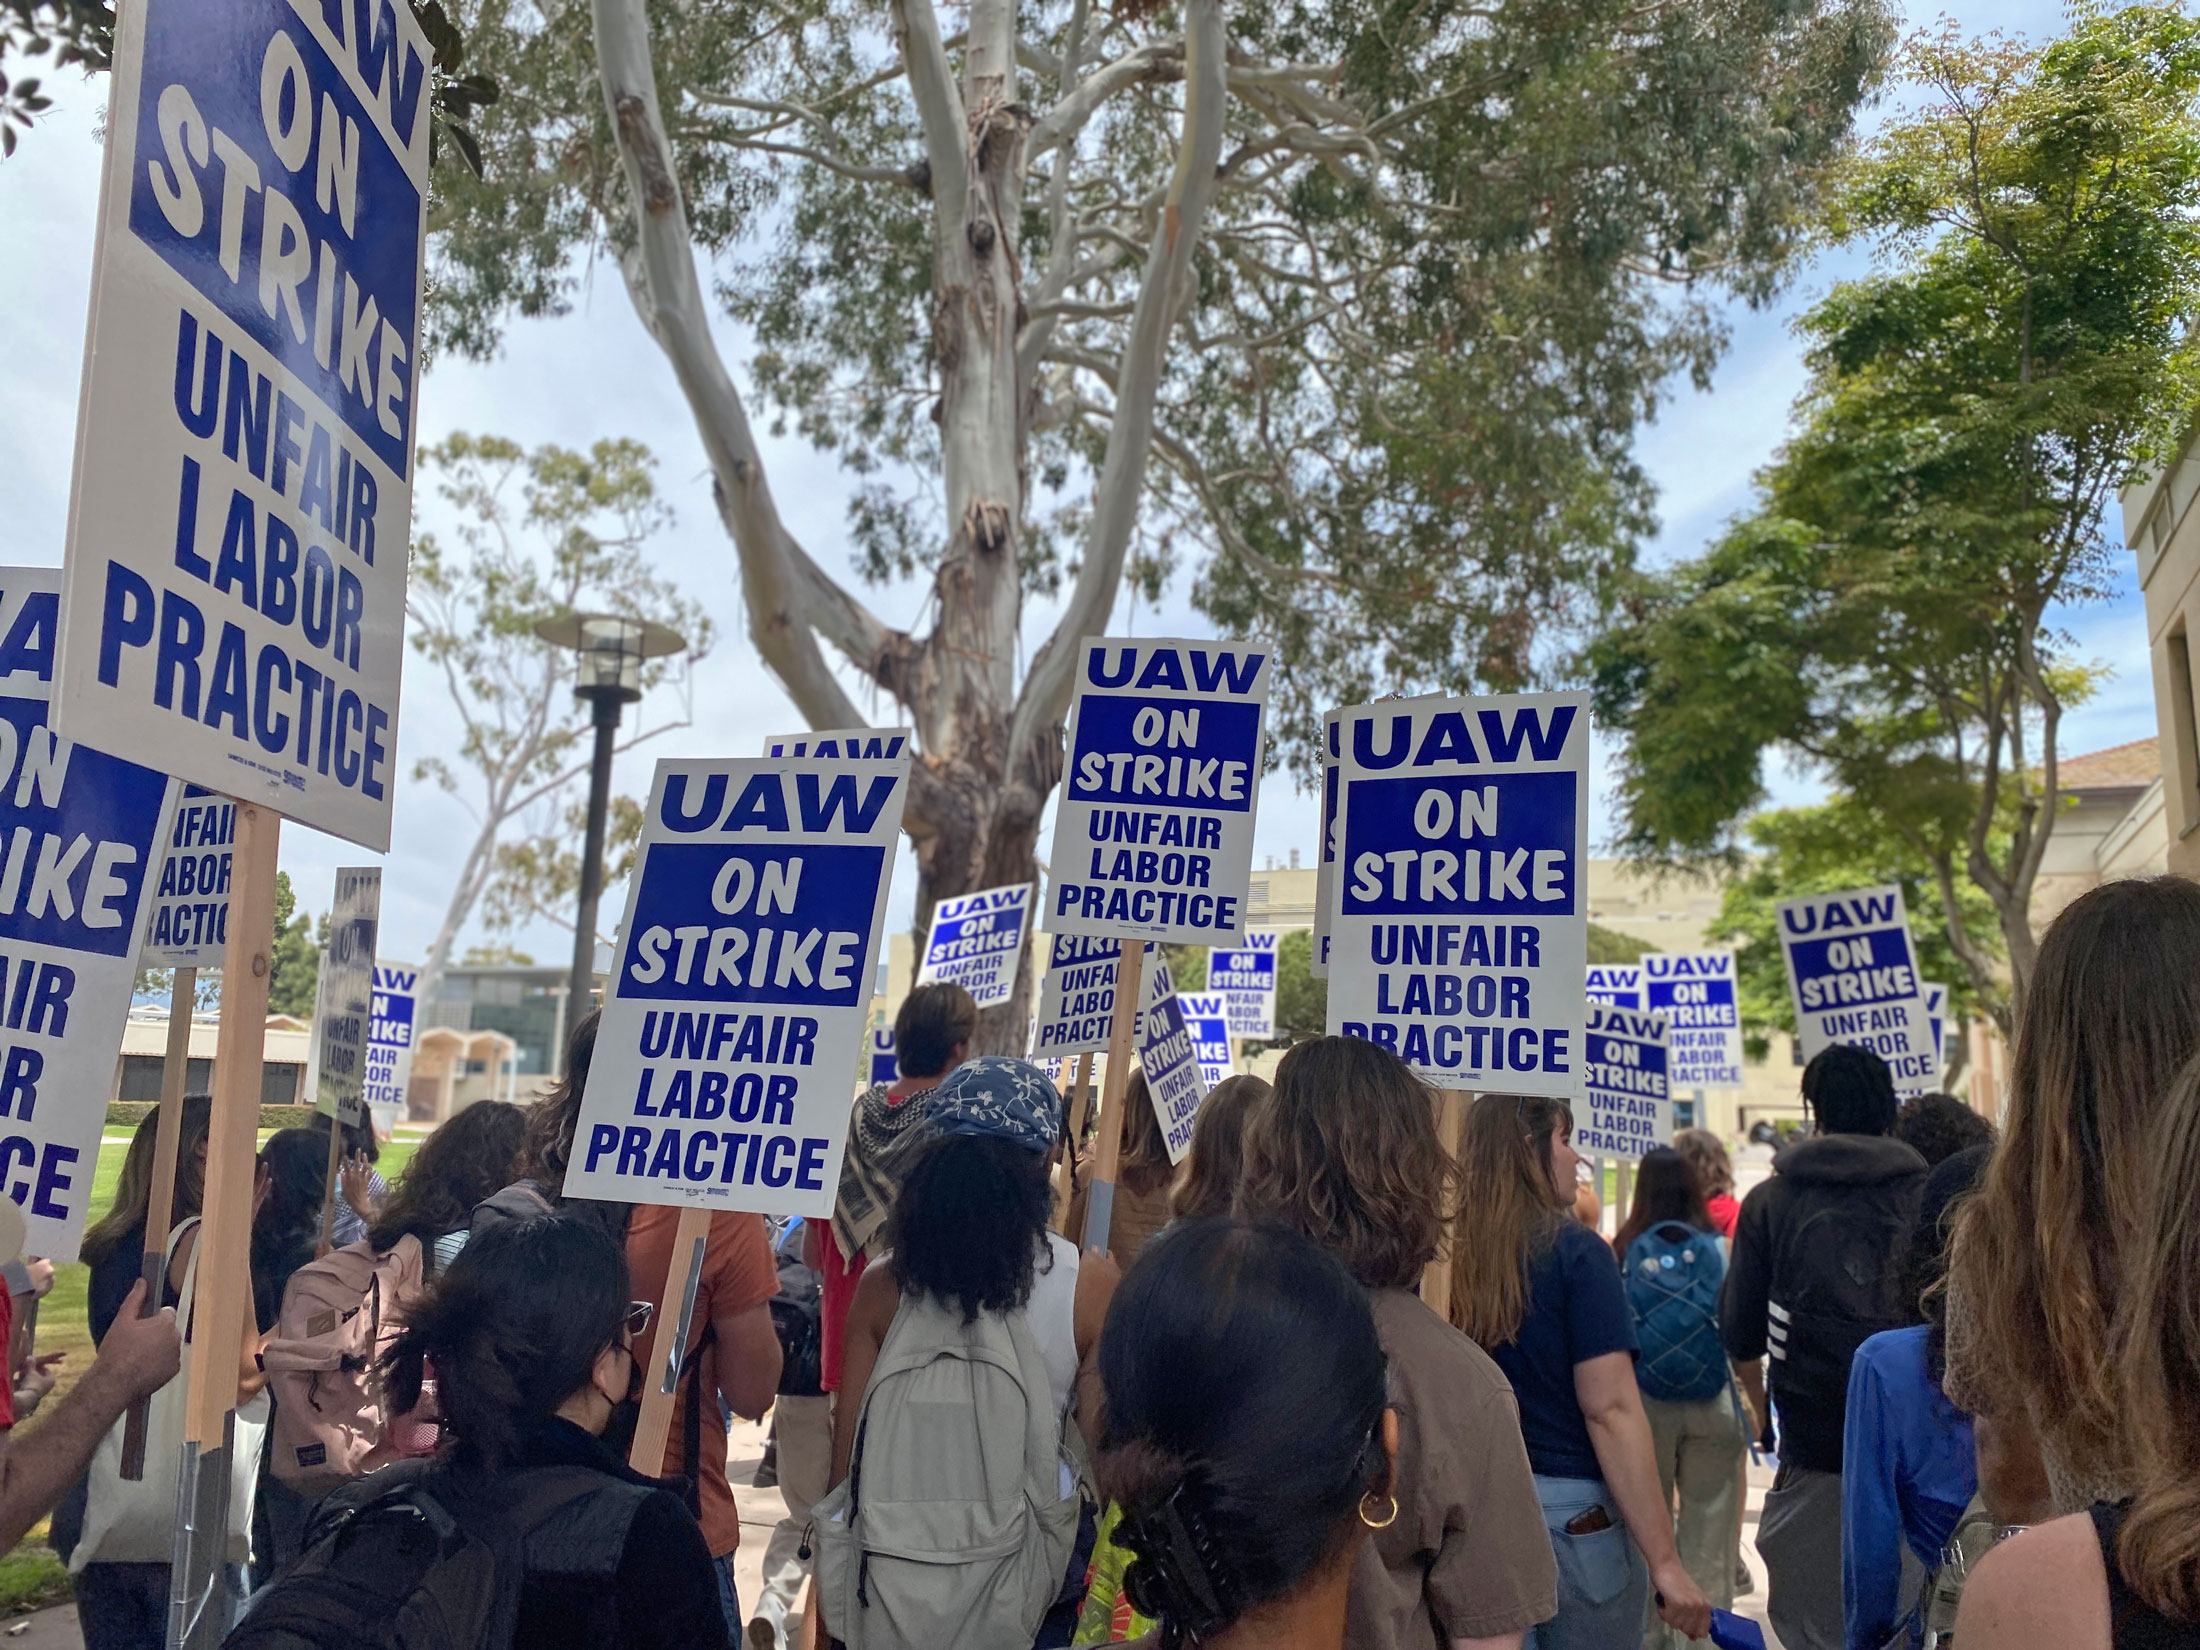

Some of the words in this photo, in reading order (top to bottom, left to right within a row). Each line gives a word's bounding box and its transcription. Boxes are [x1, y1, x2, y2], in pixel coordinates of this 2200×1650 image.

[261, 30, 359, 240] ON
[149, 84, 406, 441] STRIKE
[174, 308, 377, 567] UNFAIR
[175, 455, 364, 672] LABOR
[98, 559, 388, 801] PRACTICE
[1088, 647, 1265, 694] UAW
[1132, 706, 1200, 748] ON
[1353, 706, 1578, 770] UAW
[1076, 751, 1248, 800] STRIKE
[660, 774, 899, 833] UAW
[1414, 785, 1498, 839] ON
[1089, 810, 1222, 850] UNFAIR
[0, 826, 137, 928] IKE
[158, 853, 232, 897] ABOR
[711, 857, 803, 916] ON
[1090, 847, 1211, 888] LABOR
[1350, 847, 1567, 902] STRIKE
[940, 888, 1027, 919] UAW
[1056, 884, 1238, 930] PRACTICE
[1784, 894, 1895, 934] UAW
[931, 930, 1017, 961] STRIKE
[960, 915, 995, 937] ON
[1371, 924, 1540, 968] UNFAIR
[630, 925, 859, 990] STRIKE
[936, 955, 1003, 979] UNFAIR
[1229, 953, 1255, 970] ON
[1646, 955, 1729, 977] UAW
[1827, 936, 1874, 970] ON
[950, 971, 996, 987] ABOR
[1211, 971, 1272, 989] STRIKE
[1377, 973, 1530, 1019] LABOR
[1586, 970, 1639, 987] AW
[1672, 982, 1708, 1004] ON
[1801, 965, 1914, 1008] STRIKE
[1226, 993, 1264, 1005] NFAIR
[1227, 1006, 1261, 1018] ABOR
[369, 1018, 410, 1043] IKE
[639, 1011, 819, 1066] UNFAIR
[1040, 1011, 1144, 1047] PRACTIE
[1150, 1008, 1170, 1039] ON
[1821, 1006, 1908, 1037] UNFAIR
[366, 1048, 397, 1065] AIR
[1144, 1029, 1191, 1077] STRIKE
[1604, 1040, 1640, 1067] ON
[1674, 1049, 1725, 1064] ABOR
[633, 1068, 798, 1125] LABOR
[1159, 1065, 1195, 1103] UNFAIR
[1585, 1061, 1666, 1096] STRIKE
[1168, 1088, 1199, 1125] LABOR
[1590, 1092, 1656, 1119] UNFAIR
[1593, 1112, 1653, 1137] LABOR
[584, 1124, 829, 1190] PRACTICE
